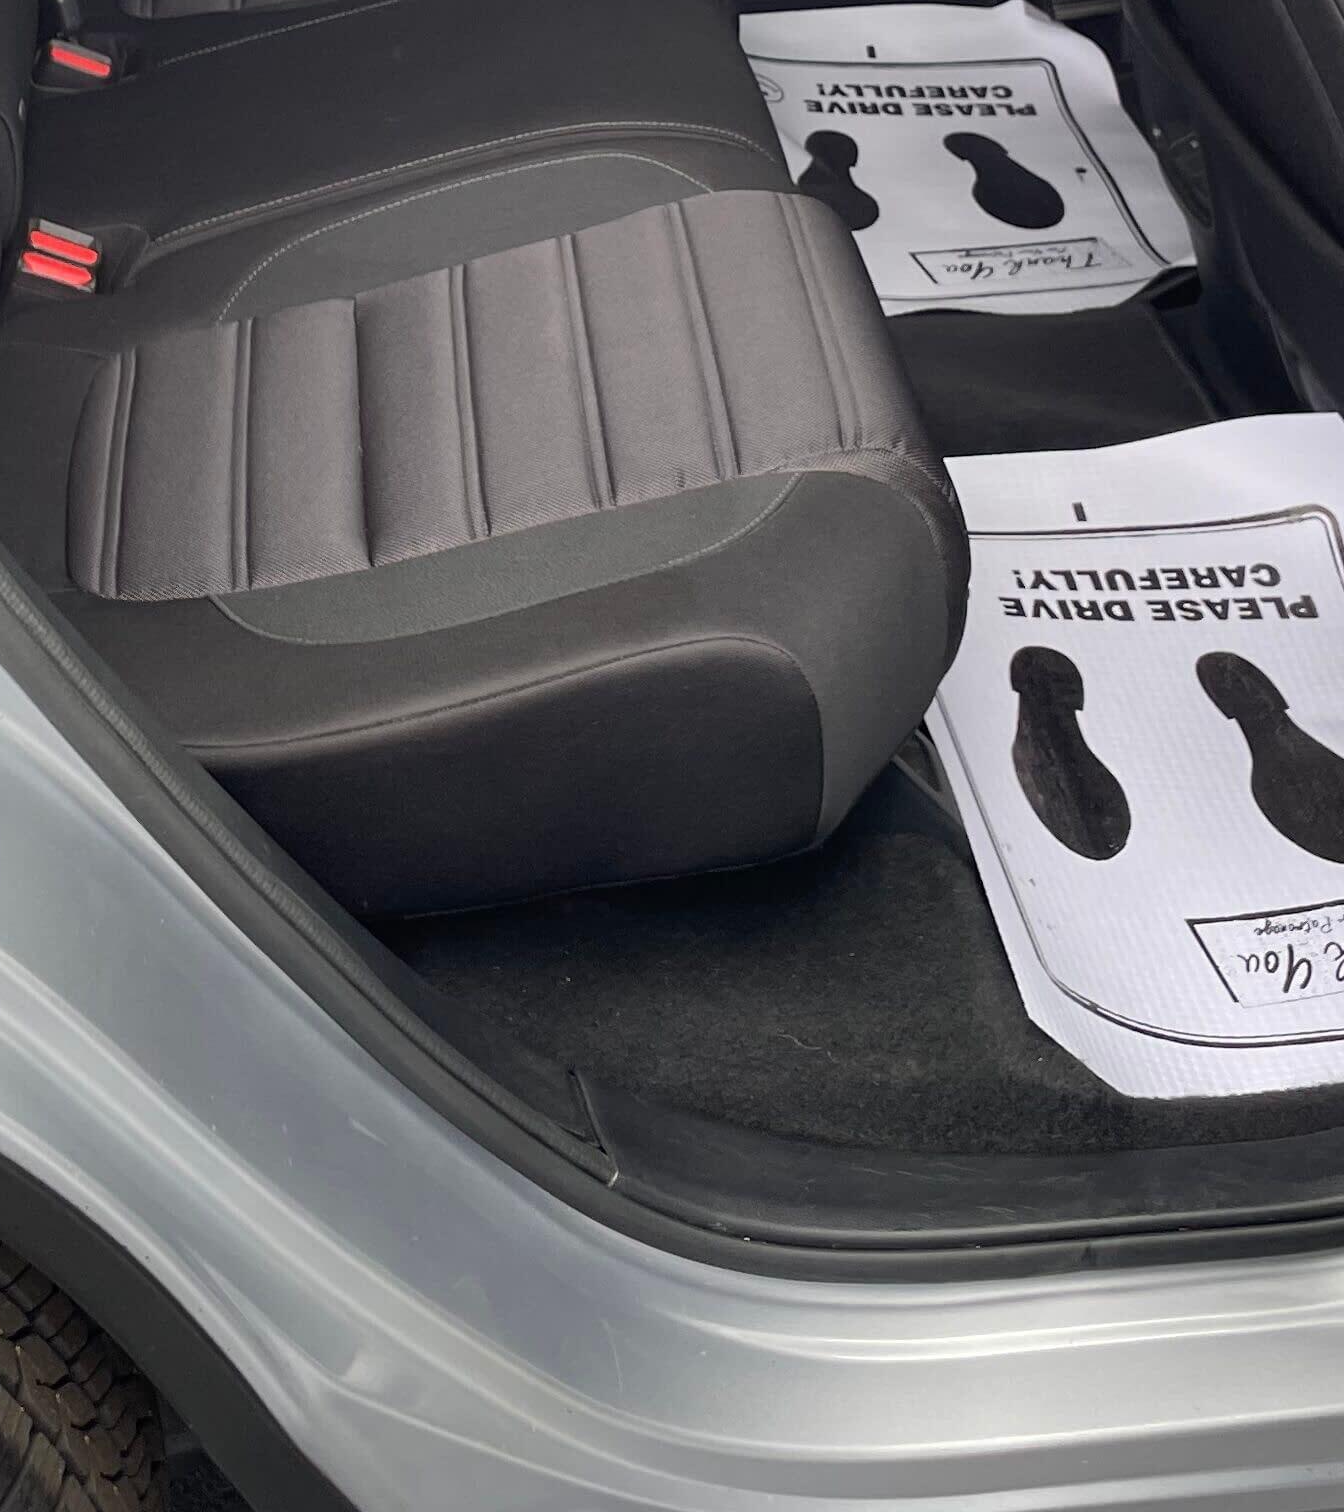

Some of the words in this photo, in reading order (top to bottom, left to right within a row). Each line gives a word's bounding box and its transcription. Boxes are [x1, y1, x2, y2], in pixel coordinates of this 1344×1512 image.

[816, 83, 1013, 99] CAREFULLY!
[805, 99, 903, 116] DRIVE
[915, 100, 1037, 116] PLEASE
[943, 260, 995, 280] You
[1001, 250, 1102, 277] Thank
[1012, 562, 1282, 592] CAREFULLY!
[999, 596, 1135, 621] DRIVE
[1146, 594, 1319, 621] PLEASE
[1237, 943, 1313, 994] You
